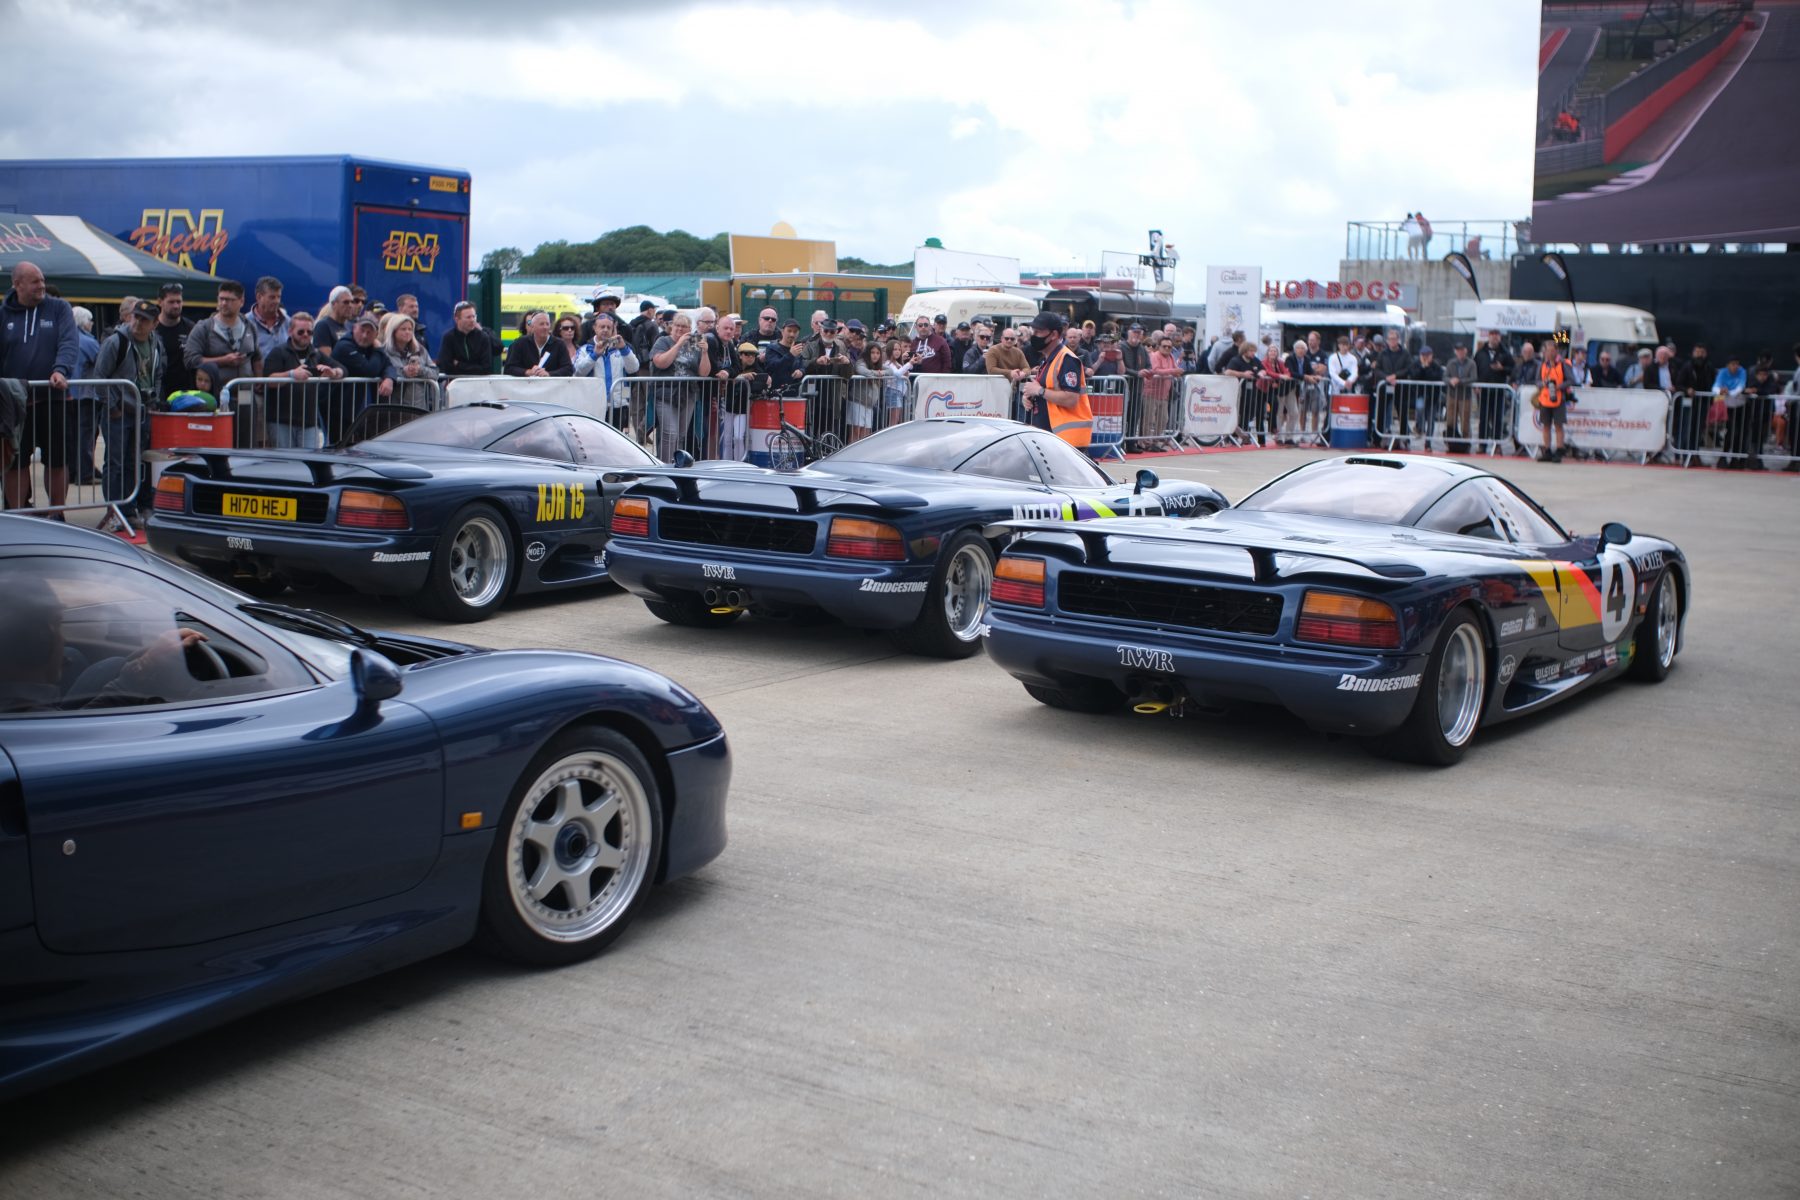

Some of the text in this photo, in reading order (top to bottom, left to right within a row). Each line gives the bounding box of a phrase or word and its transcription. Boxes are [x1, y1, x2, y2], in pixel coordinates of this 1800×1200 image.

[130, 224, 229, 264] Racing
[382, 239, 441, 260] Racing
[1265, 280, 1401, 301] HOT DOGS
[230, 496, 288, 516] H170 HEJ
[536, 483, 585, 522] XJR 15
[1163, 494, 1196, 509] FANGIO
[371, 551, 431, 563] BRIDGESTONE
[1634, 552, 1664, 573] WOLLEK
[702, 564, 736, 580] TWR
[859, 578, 928, 593] BRIDGESTONE
[1607, 563, 1626, 622] 4
[1117, 644, 1175, 673] TWR
[1336, 673, 1422, 692] BRIDGESTONE
[1535, 664, 1561, 681] BILSTEIN
